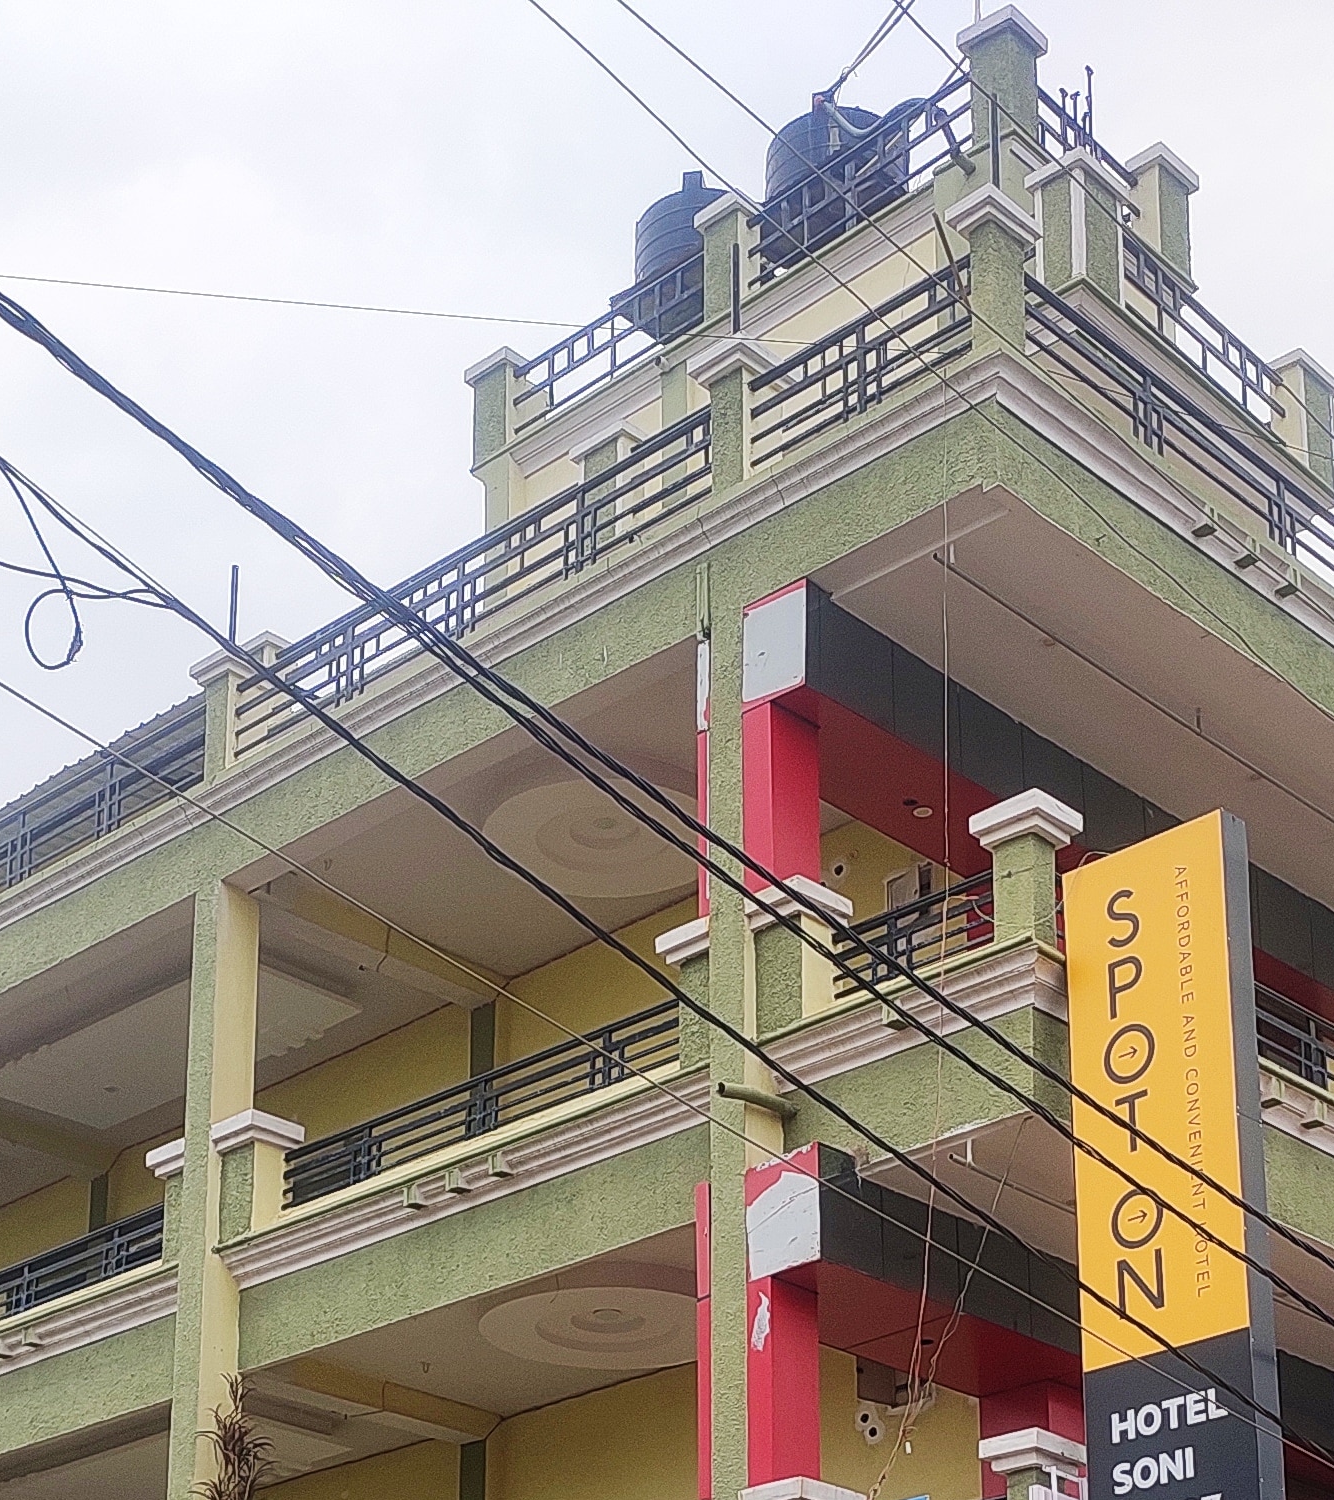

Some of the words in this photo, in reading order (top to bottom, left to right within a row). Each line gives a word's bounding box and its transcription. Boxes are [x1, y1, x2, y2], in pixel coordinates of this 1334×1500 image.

[1174, 865, 1194, 1004] AFFORDABLE
[1104, 889, 1155, 1152] SPOT
[1183, 1014, 1198, 1060] AND
[1111, 1187, 1165, 1320] ON
[1194, 1221, 1211, 1298] OTEL
[1111, 1388, 1229, 1444] HOTEL
[1112, 1446, 1195, 1495] SONI
